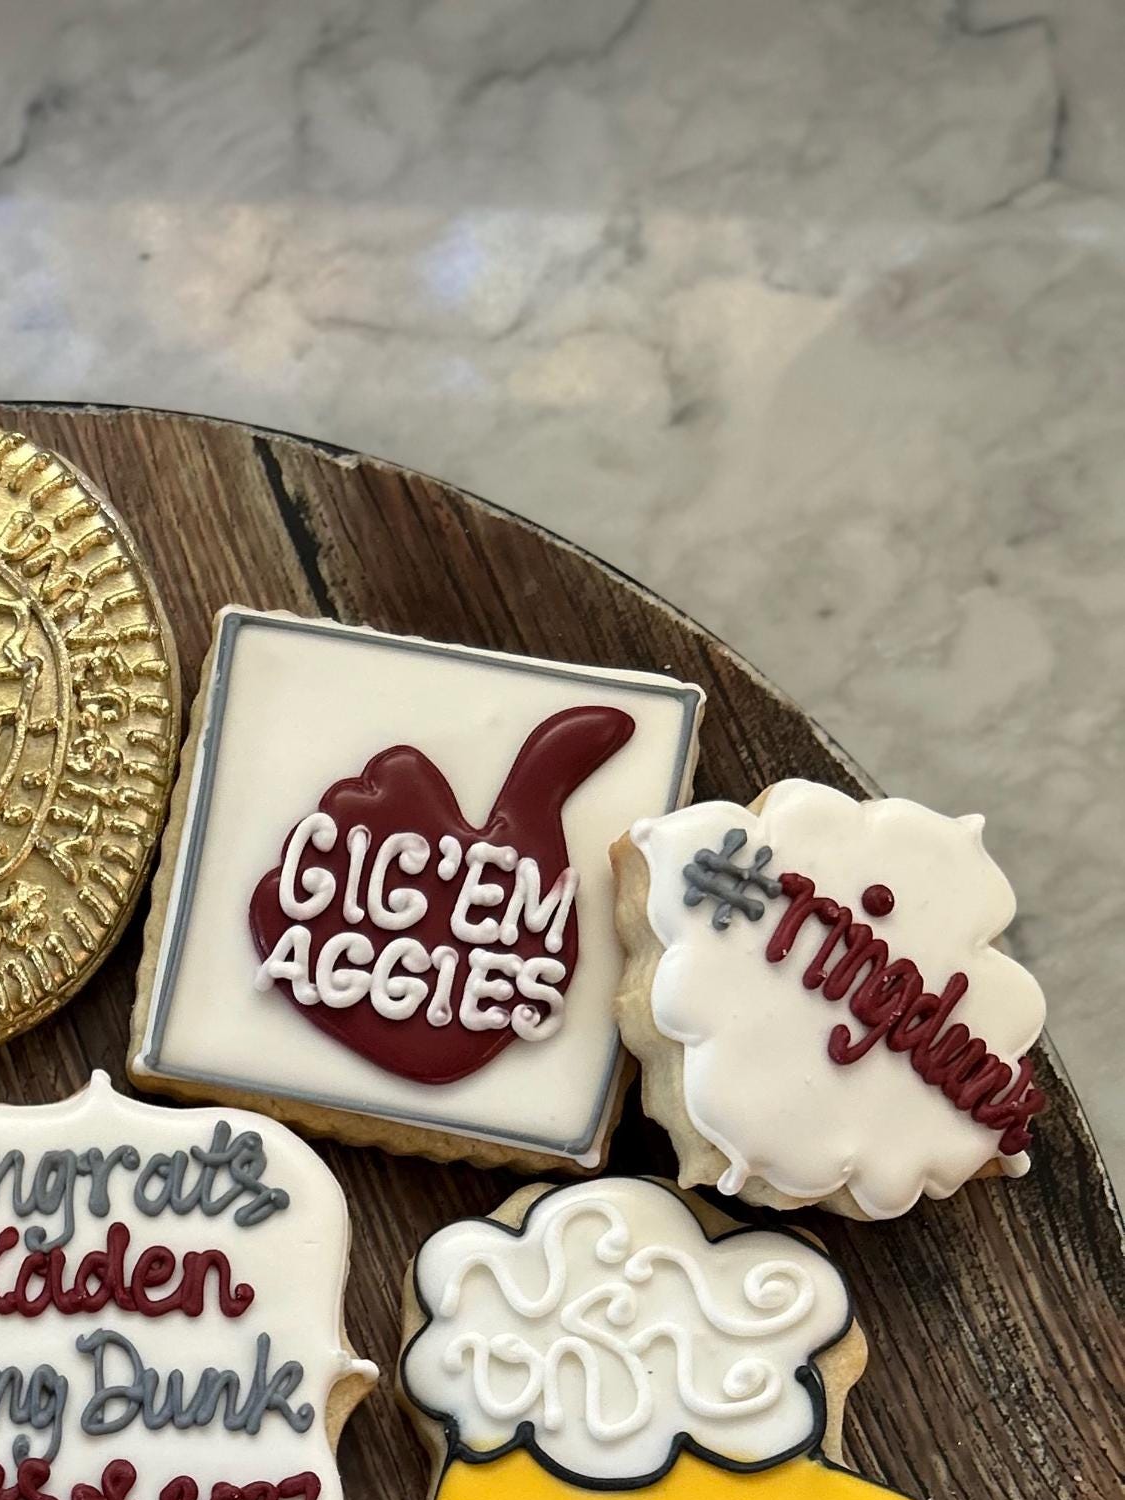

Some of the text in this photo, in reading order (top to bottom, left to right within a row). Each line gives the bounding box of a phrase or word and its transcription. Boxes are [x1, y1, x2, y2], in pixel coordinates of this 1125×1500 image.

[279, 812, 579, 953] GIG'EM
[254, 925, 566, 1042] AGGIES
[76, 1327, 314, 1436] Dunk
